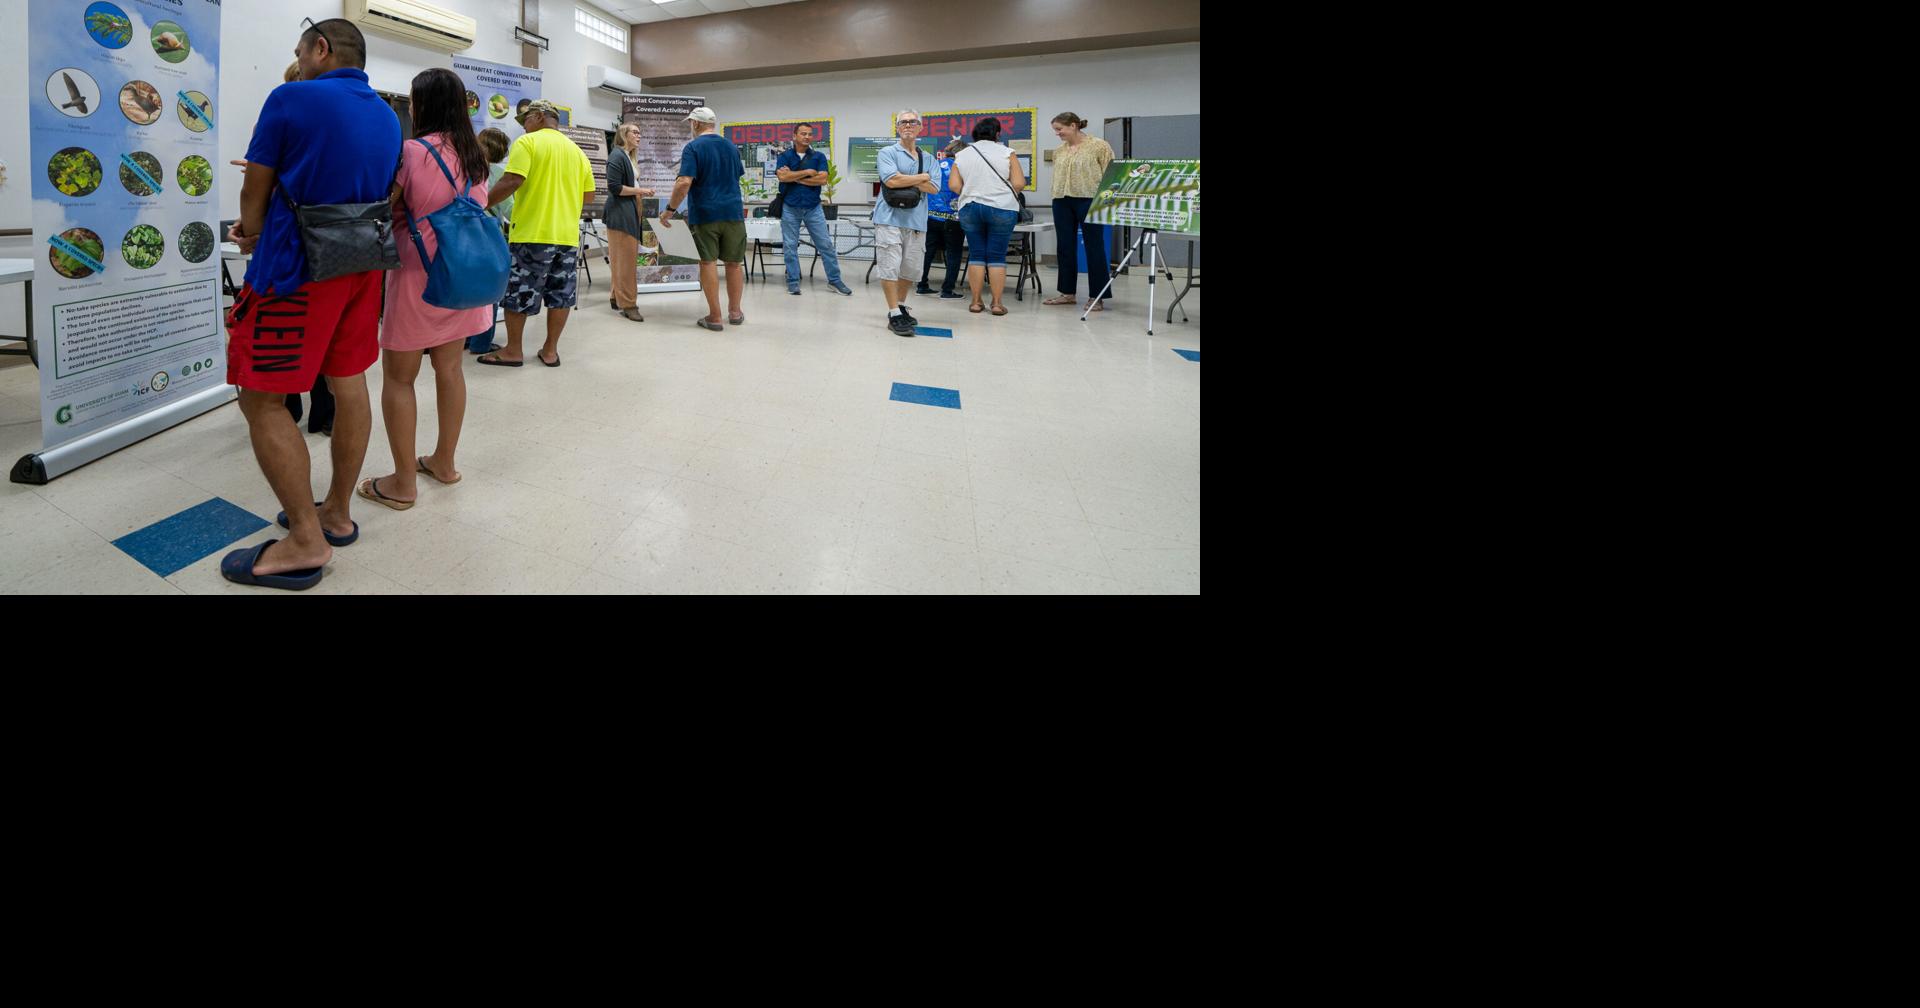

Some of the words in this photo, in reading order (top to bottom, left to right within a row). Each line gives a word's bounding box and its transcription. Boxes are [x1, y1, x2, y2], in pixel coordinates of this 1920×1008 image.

[471, 65, 492, 74] HABITAT
[493, 70, 529, 80] CONSERVATION
[477, 75, 500, 84] COVERED
[502, 79, 521, 87] SPECIES
[51, 236, 63, 246] NOW
[68, 247, 88, 262] COVERED
[91, 308, 119, 318] population
[122, 309, 146, 317] individual
[67, 328, 96, 338] jeopardize
[252, 291, 309, 372] KLEIN
[68, 351, 97, 361] Avoidance
[86, 356, 106, 365] impacts
[76, 397, 106, 409] UNIVERSITY
